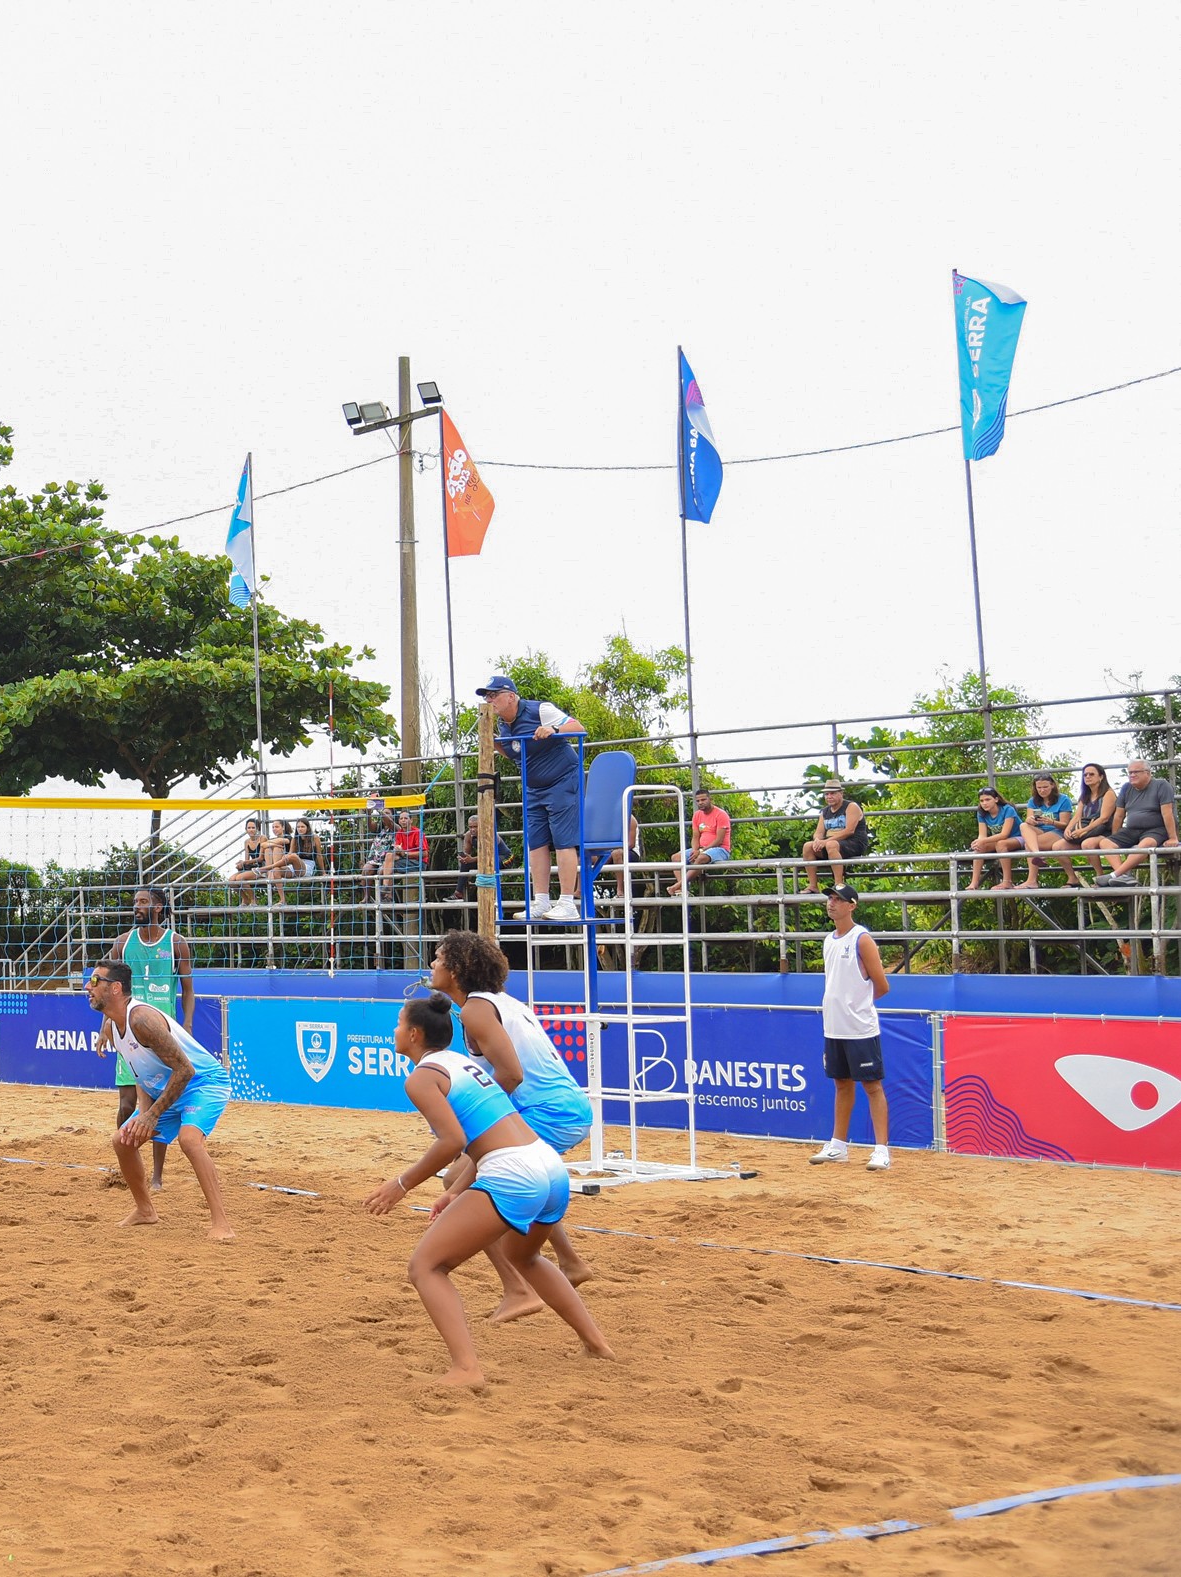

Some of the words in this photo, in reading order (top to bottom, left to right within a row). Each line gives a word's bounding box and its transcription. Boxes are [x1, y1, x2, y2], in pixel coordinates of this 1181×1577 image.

[457, 469, 471, 494] 2023
[143, 964, 150, 980] 1
[35, 1029, 88, 1052] ARENA
[346, 1034, 384, 1044] PREFEITURA
[348, 1046, 412, 1077] SERR
[463, 1064, 494, 1088] 2
[684, 1059, 807, 1093] BANESTES
[761, 1094, 807, 1113] juntos
